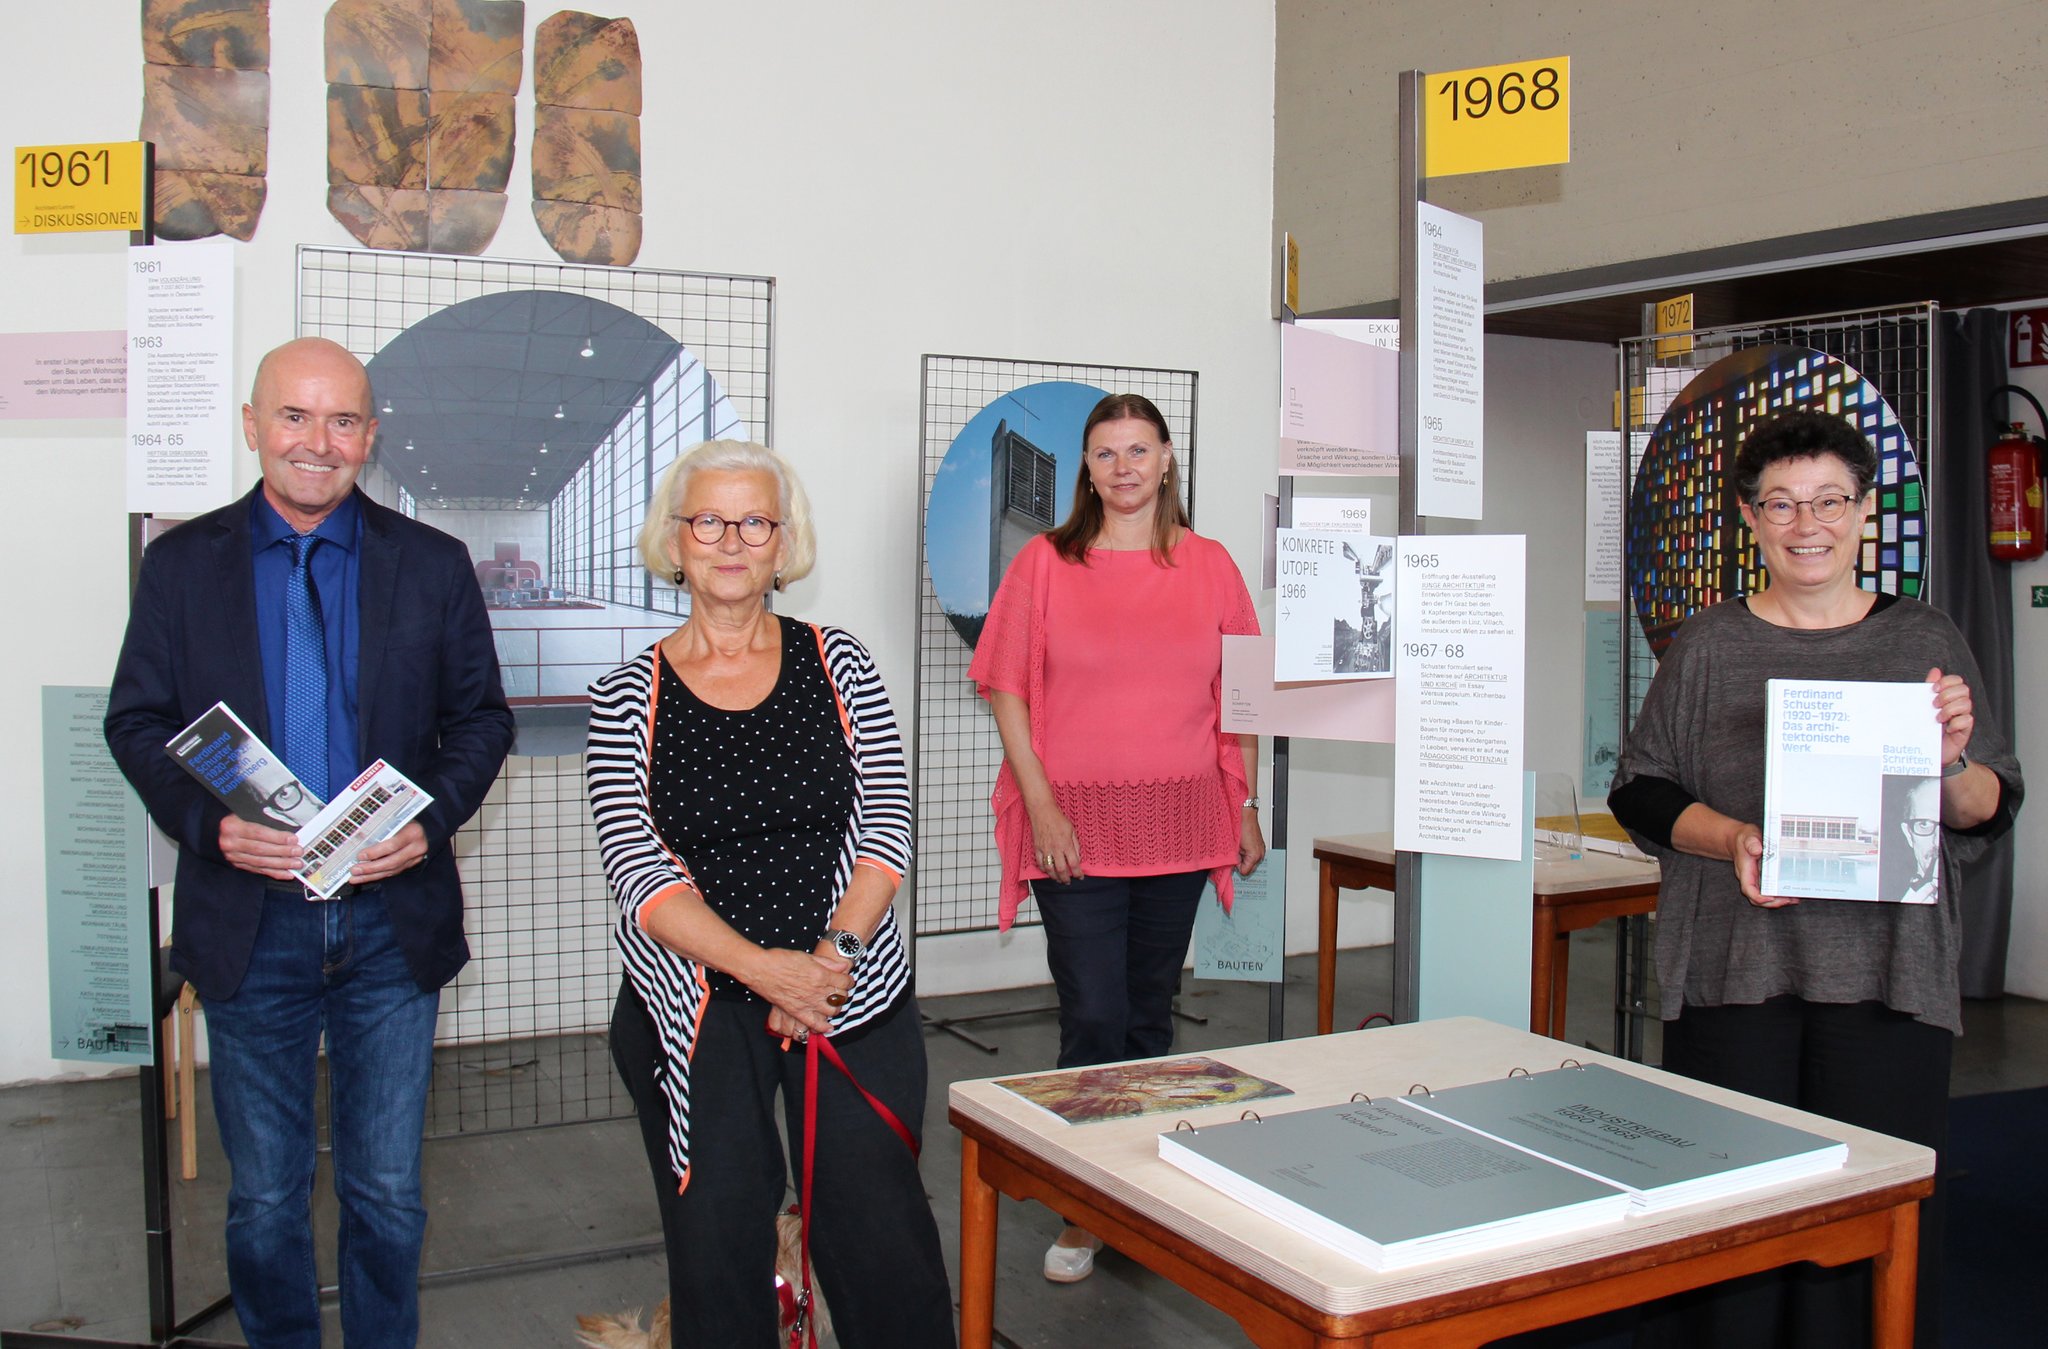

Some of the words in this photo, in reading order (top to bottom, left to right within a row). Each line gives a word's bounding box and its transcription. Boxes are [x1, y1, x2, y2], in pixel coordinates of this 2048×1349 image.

[1439, 68, 1560, 121] 1968
[20, 150, 109, 188] 1961
[34, 211, 138, 228] DISKUSSIONEN
[132, 260, 162, 273] 1961
[1662, 300, 1690, 328] 1972
[1368, 324, 1398, 334] EXKU
[132, 336, 163, 349] 1963
[1423, 416, 1442, 431] 1965
[1341, 509, 1367, 519] 1969
[1282, 537, 1334, 555] KONKRETE
[1404, 554, 1439, 568] 1965
[1282, 560, 1318, 576] UTOPIE
[1282, 583, 1306, 598] 1966
[1783, 688, 1843, 699] Ferdinand
[1783, 700, 1834, 710] Schuster
[1782, 722, 1803, 731] Das
[1806, 722, 1839, 732] archi-
[1782, 733, 1850, 743] tektonische
[188, 731, 232, 767] Ferdinand
[1782, 744, 1811, 752] Werk
[1882, 744, 1922, 755] Bauten,
[1882, 755, 1933, 766] Schriften,
[353, 764, 382, 790] KAPFENBERG
[1882, 765, 1930, 776] Analysen
[1482, 811, 1506, 819] Wirkung
[1419, 825, 1460, 833] Entwicklungen
[1466, 819, 1511, 828] wirtschaftlicher
[1217, 960, 1263, 971] BAUTEN
[77, 1038, 129, 1052] BAUTEN
[1354, 1110, 1383, 1121] und
[1372, 1107, 1442, 1135] Architektur
[1554, 1107, 1595, 1124] 1960
[1598, 1124, 1641, 1140] 1968
[1567, 1103, 1696, 1147] INDUSTRIEBAU
